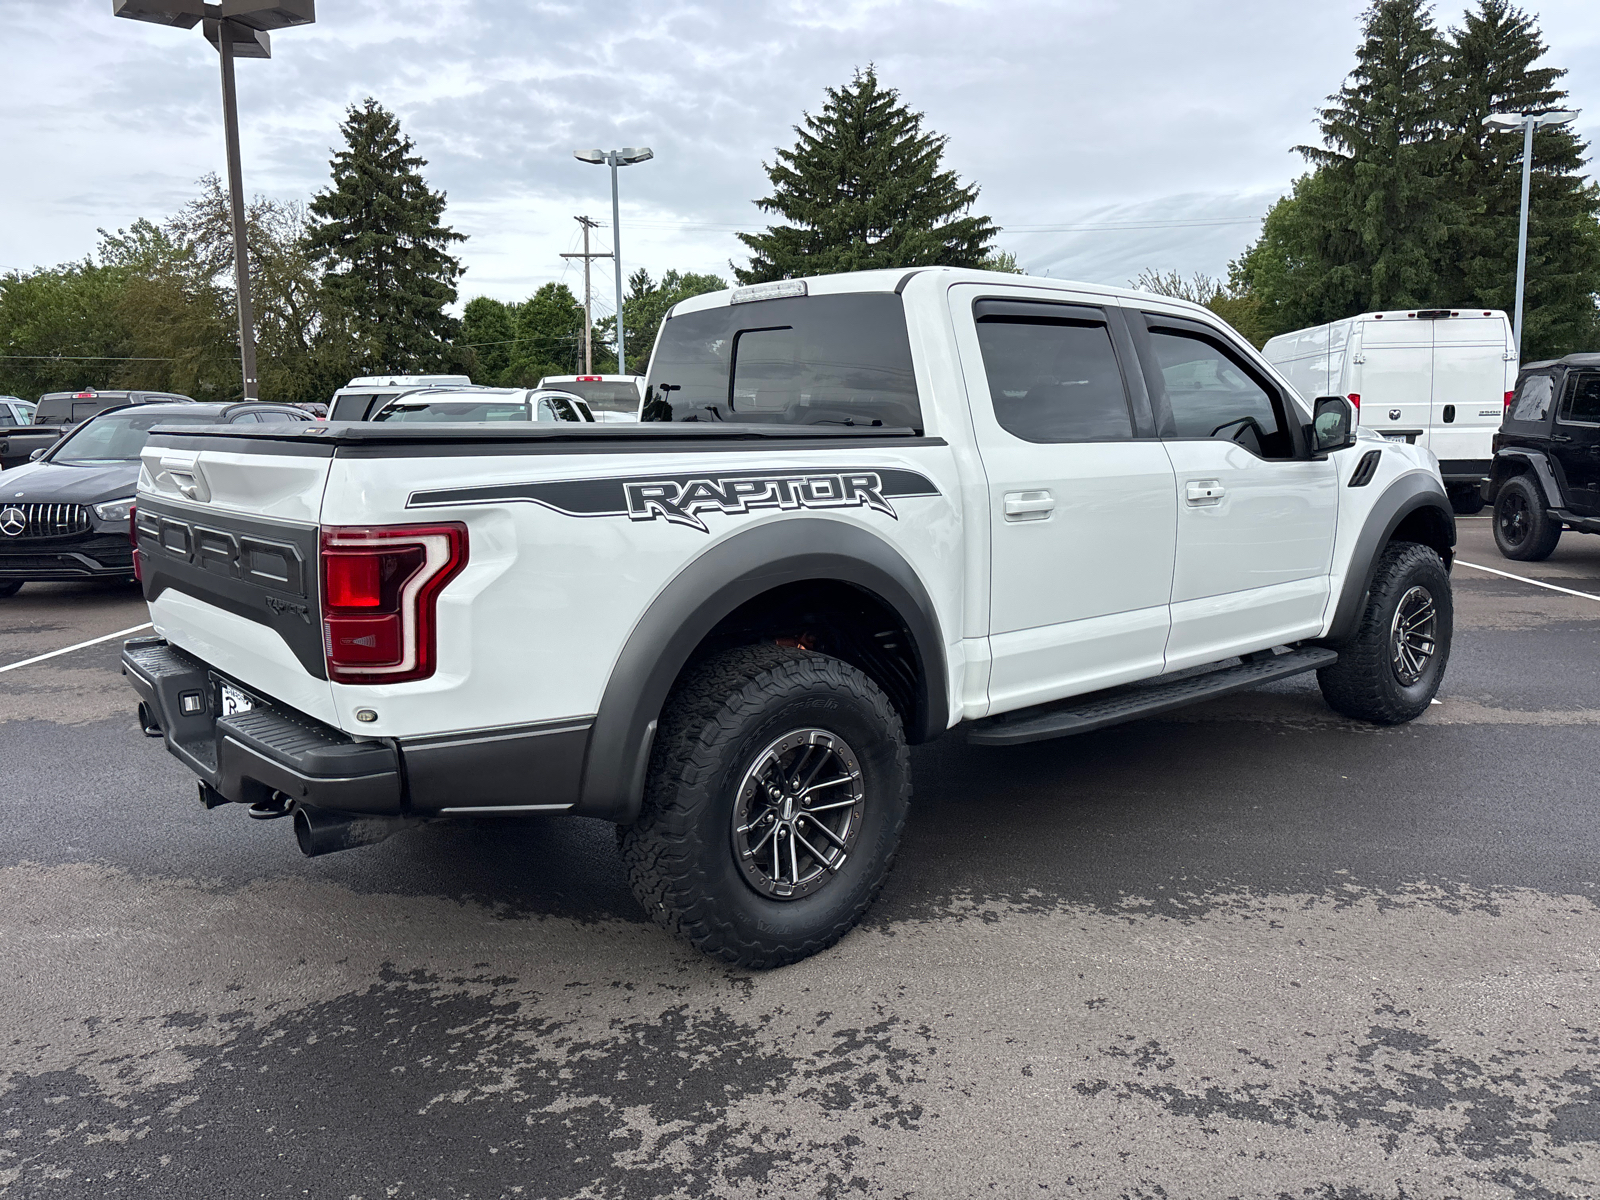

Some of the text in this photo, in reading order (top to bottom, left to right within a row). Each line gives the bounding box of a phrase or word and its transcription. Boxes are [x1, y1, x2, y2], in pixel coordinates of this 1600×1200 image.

[622, 471, 899, 535] RAPTOR
[136, 507, 308, 600] FORD
[265, 595, 312, 626] RAPTOR
